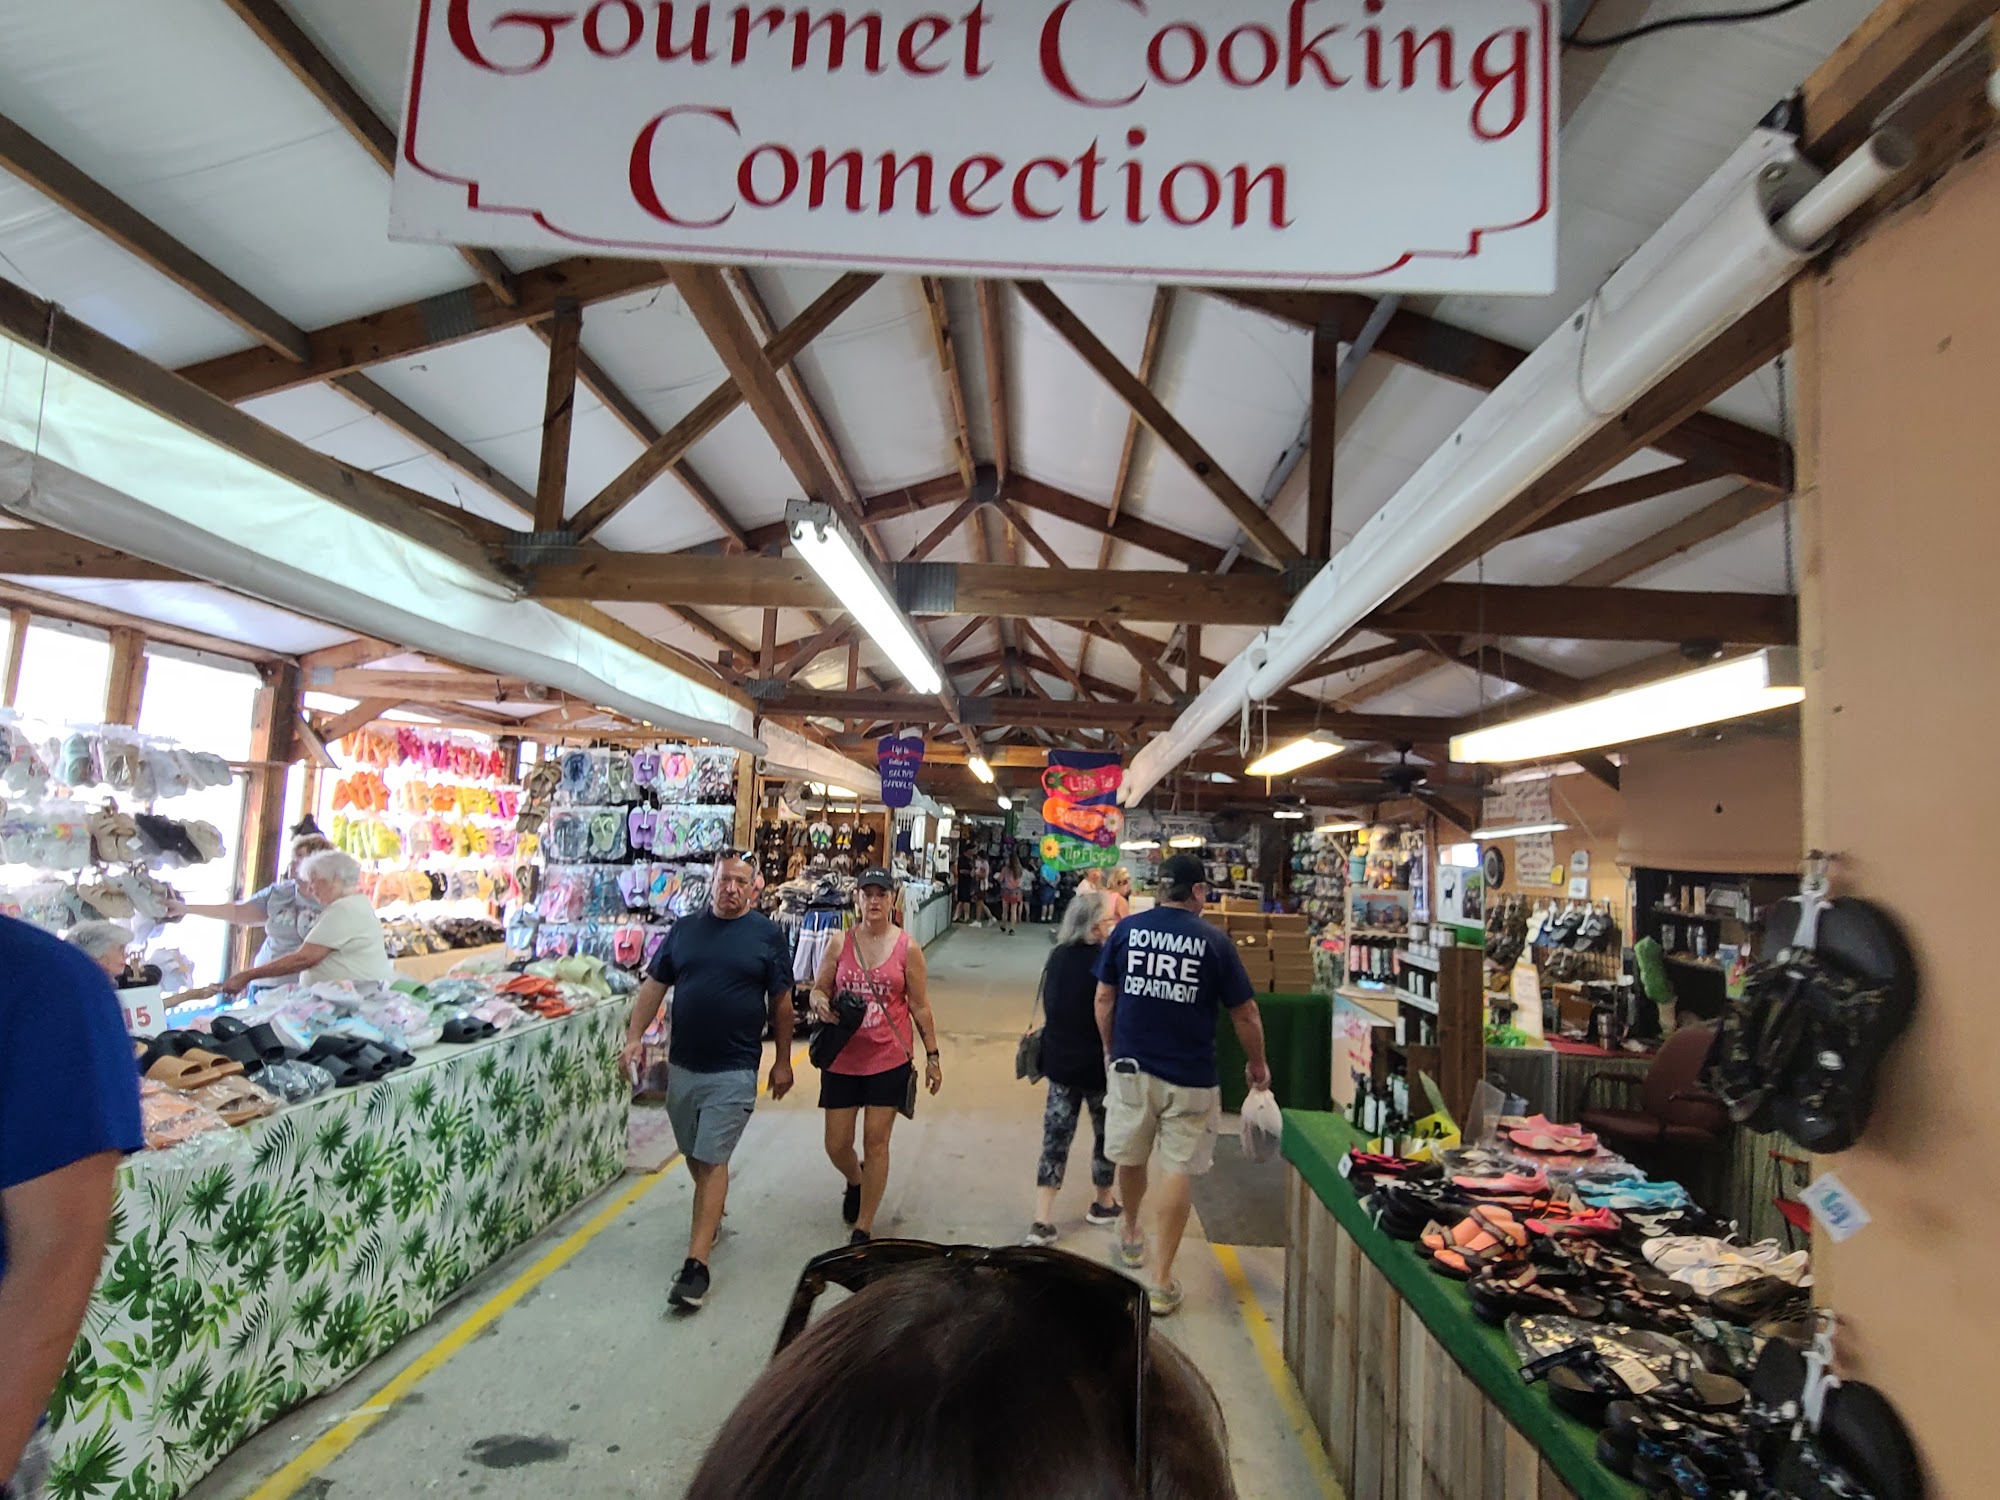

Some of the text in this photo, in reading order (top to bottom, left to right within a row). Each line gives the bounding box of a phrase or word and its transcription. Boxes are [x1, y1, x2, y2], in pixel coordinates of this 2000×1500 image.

[446, 0, 1532, 141] Gourmet Cooking
[629, 103, 1297, 230] Connection
[1128, 928, 1206, 957] BOWMAN
[1127, 950, 1201, 983] FIRE
[1124, 975, 1199, 1004] DEPARTMENT
